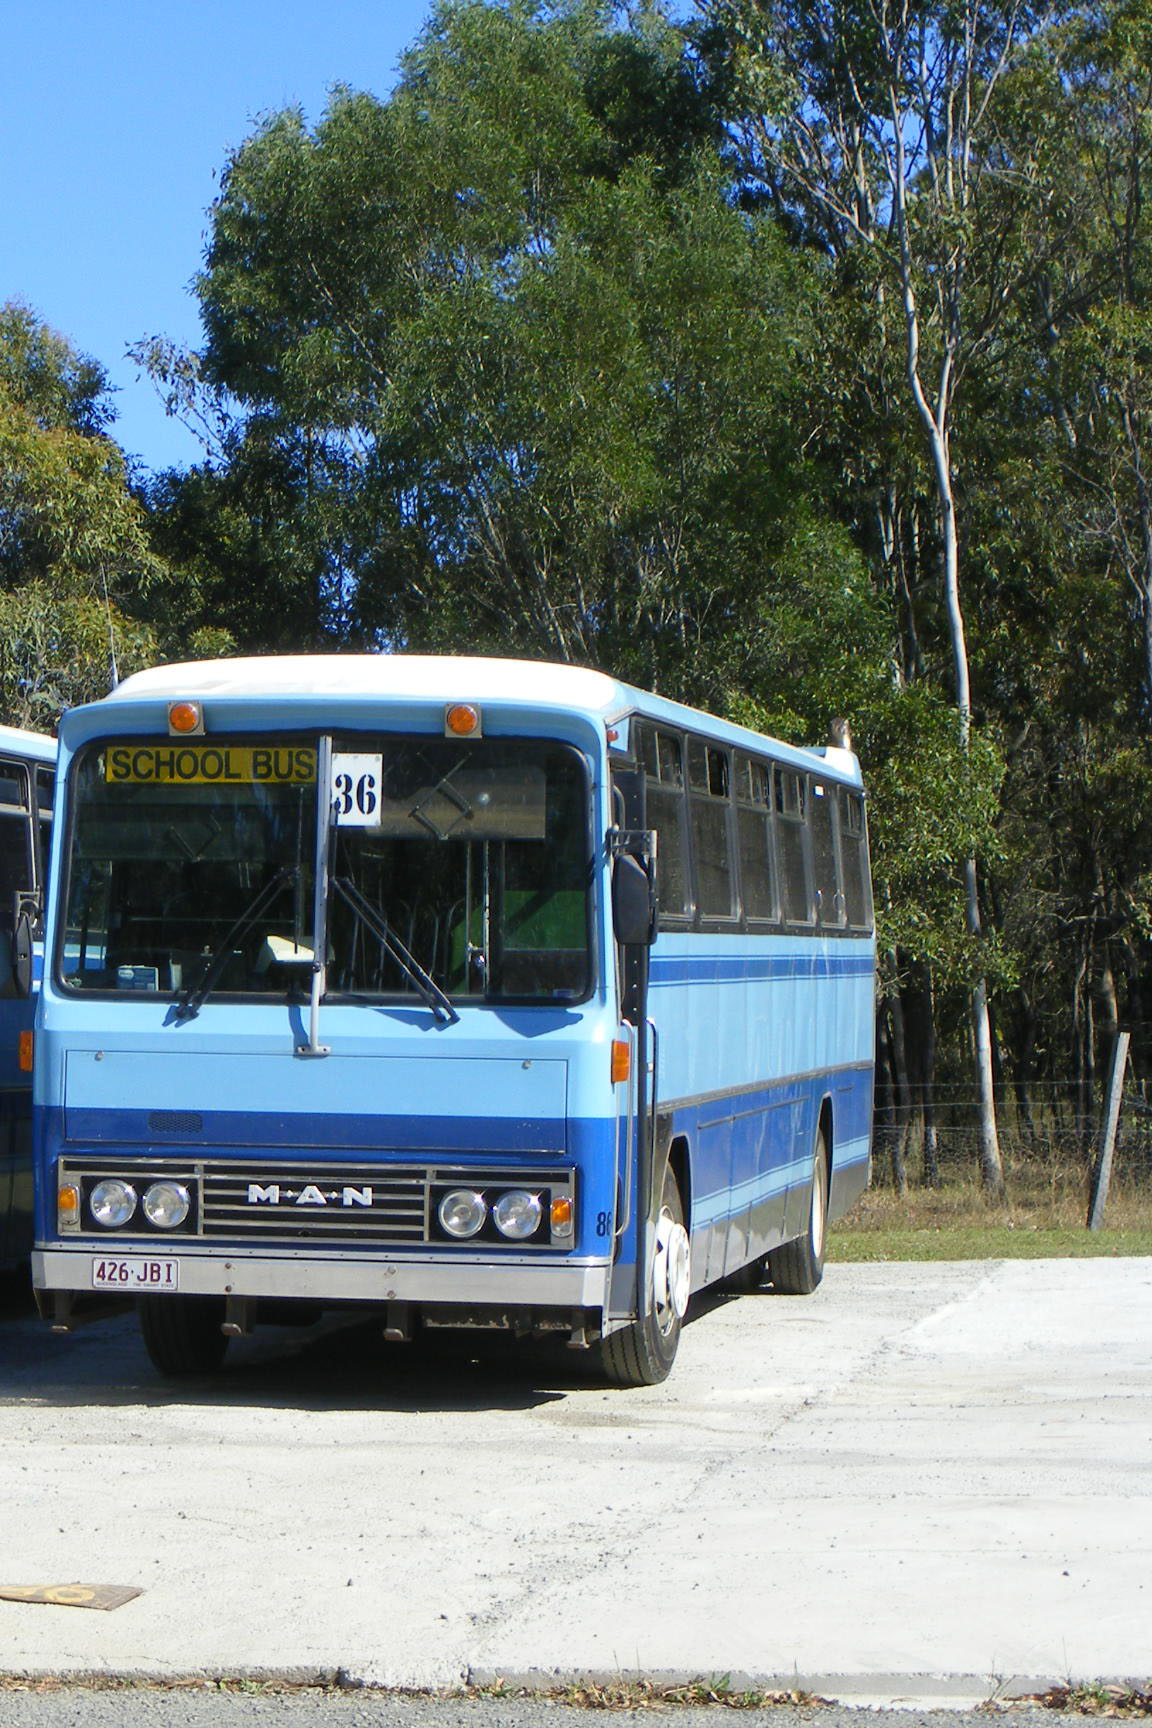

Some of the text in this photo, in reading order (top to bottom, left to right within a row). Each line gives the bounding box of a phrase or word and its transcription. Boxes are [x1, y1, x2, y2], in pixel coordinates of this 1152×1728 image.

[111, 750, 315, 780] SCHOOL BUS
[334, 773, 377, 815] 36
